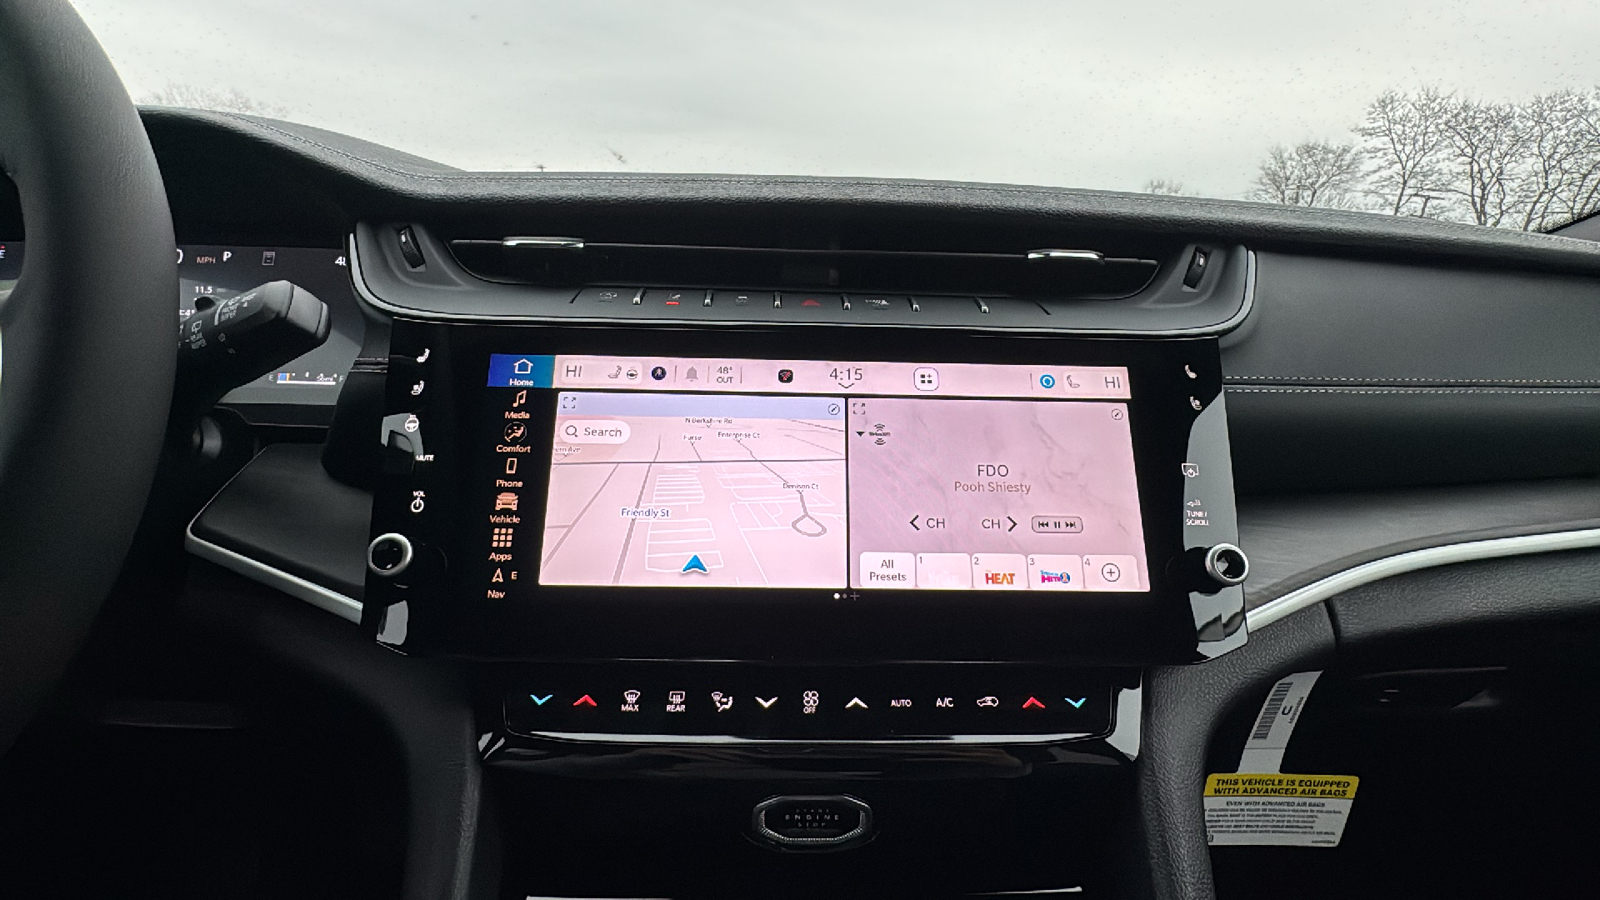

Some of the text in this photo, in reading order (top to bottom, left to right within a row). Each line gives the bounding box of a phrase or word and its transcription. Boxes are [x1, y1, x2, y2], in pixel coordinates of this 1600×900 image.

[196, 256, 216, 264] MPH
[223, 251, 232, 262] P
[195, 286, 213, 294] 11.5
[566, 366, 582, 377] HI
[716, 366, 733, 375] 48°
[829, 368, 863, 381] 4:15
[509, 378, 534, 386] Home
[716, 376, 734, 384] OUT
[1104, 377, 1121, 388] HI
[505, 411, 530, 419] Media
[584, 427, 622, 437] Search
[496, 445, 531, 453] Comfort
[977, 465, 1009, 477] FDO
[496, 479, 523, 488] Phone
[954, 481, 1031, 495] Pooh Shiesty
[621, 507, 670, 519] Friendly St
[1186, 510, 1204, 518] TUNE
[490, 514, 521, 524] Vehicle
[926, 517, 946, 530] CH
[981, 518, 1001, 530] CH
[1186, 518, 1209, 526] SCROLL
[488, 552, 512, 562] Apps
[974, 557, 979, 565] 2
[1029, 558, 1035, 566] 3
[1084, 557, 1091, 567] 4
[880, 559, 895, 569] All
[511, 571, 517, 580] E
[869, 571, 907, 582] Presets
[985, 573, 1015, 585] HEAT
[487, 590, 505, 598] Nav
[891, 699, 912, 707] AUTO
[936, 697, 954, 707] A/C
[666, 704, 686, 712] REAR
[1216, 778, 1239, 786] THIS
[1241, 779, 1283, 787] VEHICLE
[1298, 780, 1350, 788] EQUIPPED
[1242, 787, 1298, 796] ADVANCED
[1301, 788, 1317, 796] AIR
[1319, 788, 1347, 797] BAGS
